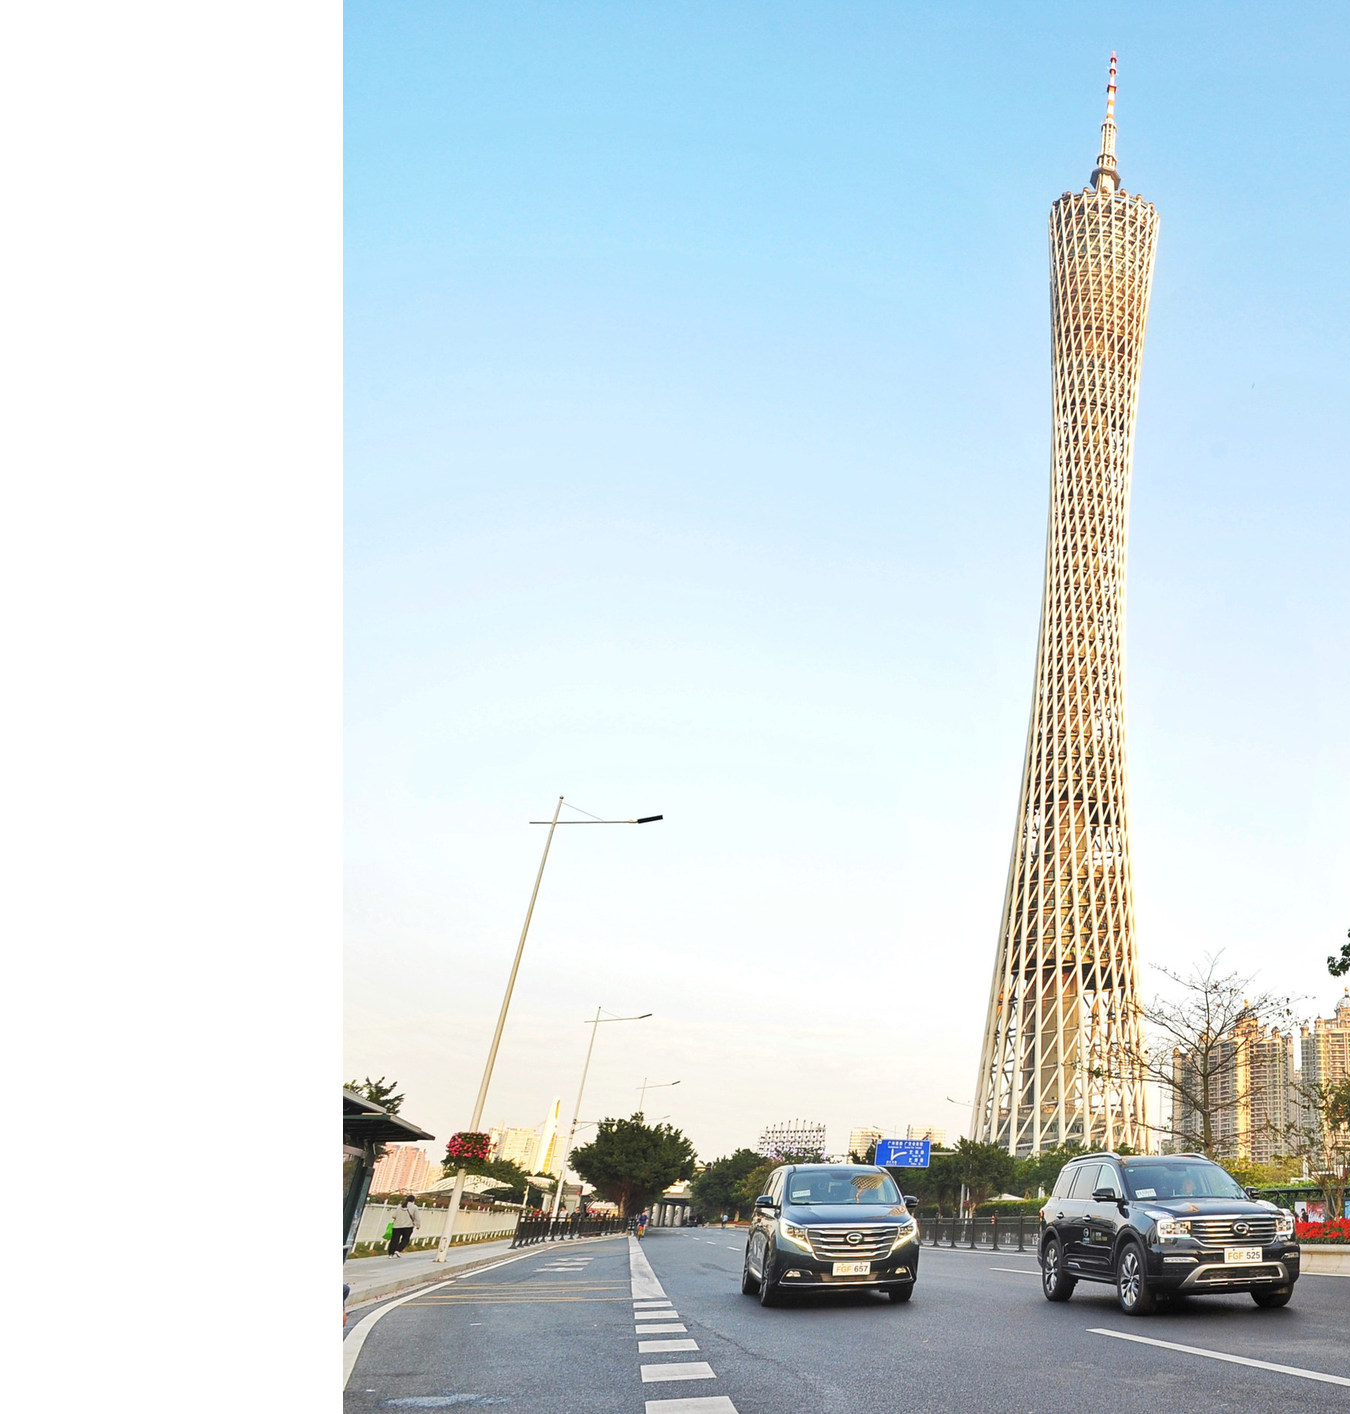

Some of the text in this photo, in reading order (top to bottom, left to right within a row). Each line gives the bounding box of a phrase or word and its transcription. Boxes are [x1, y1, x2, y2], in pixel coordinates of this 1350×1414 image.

[1226, 1251, 1261, 1260] FGF 525
[836, 1265, 869, 1273] FGF 657
